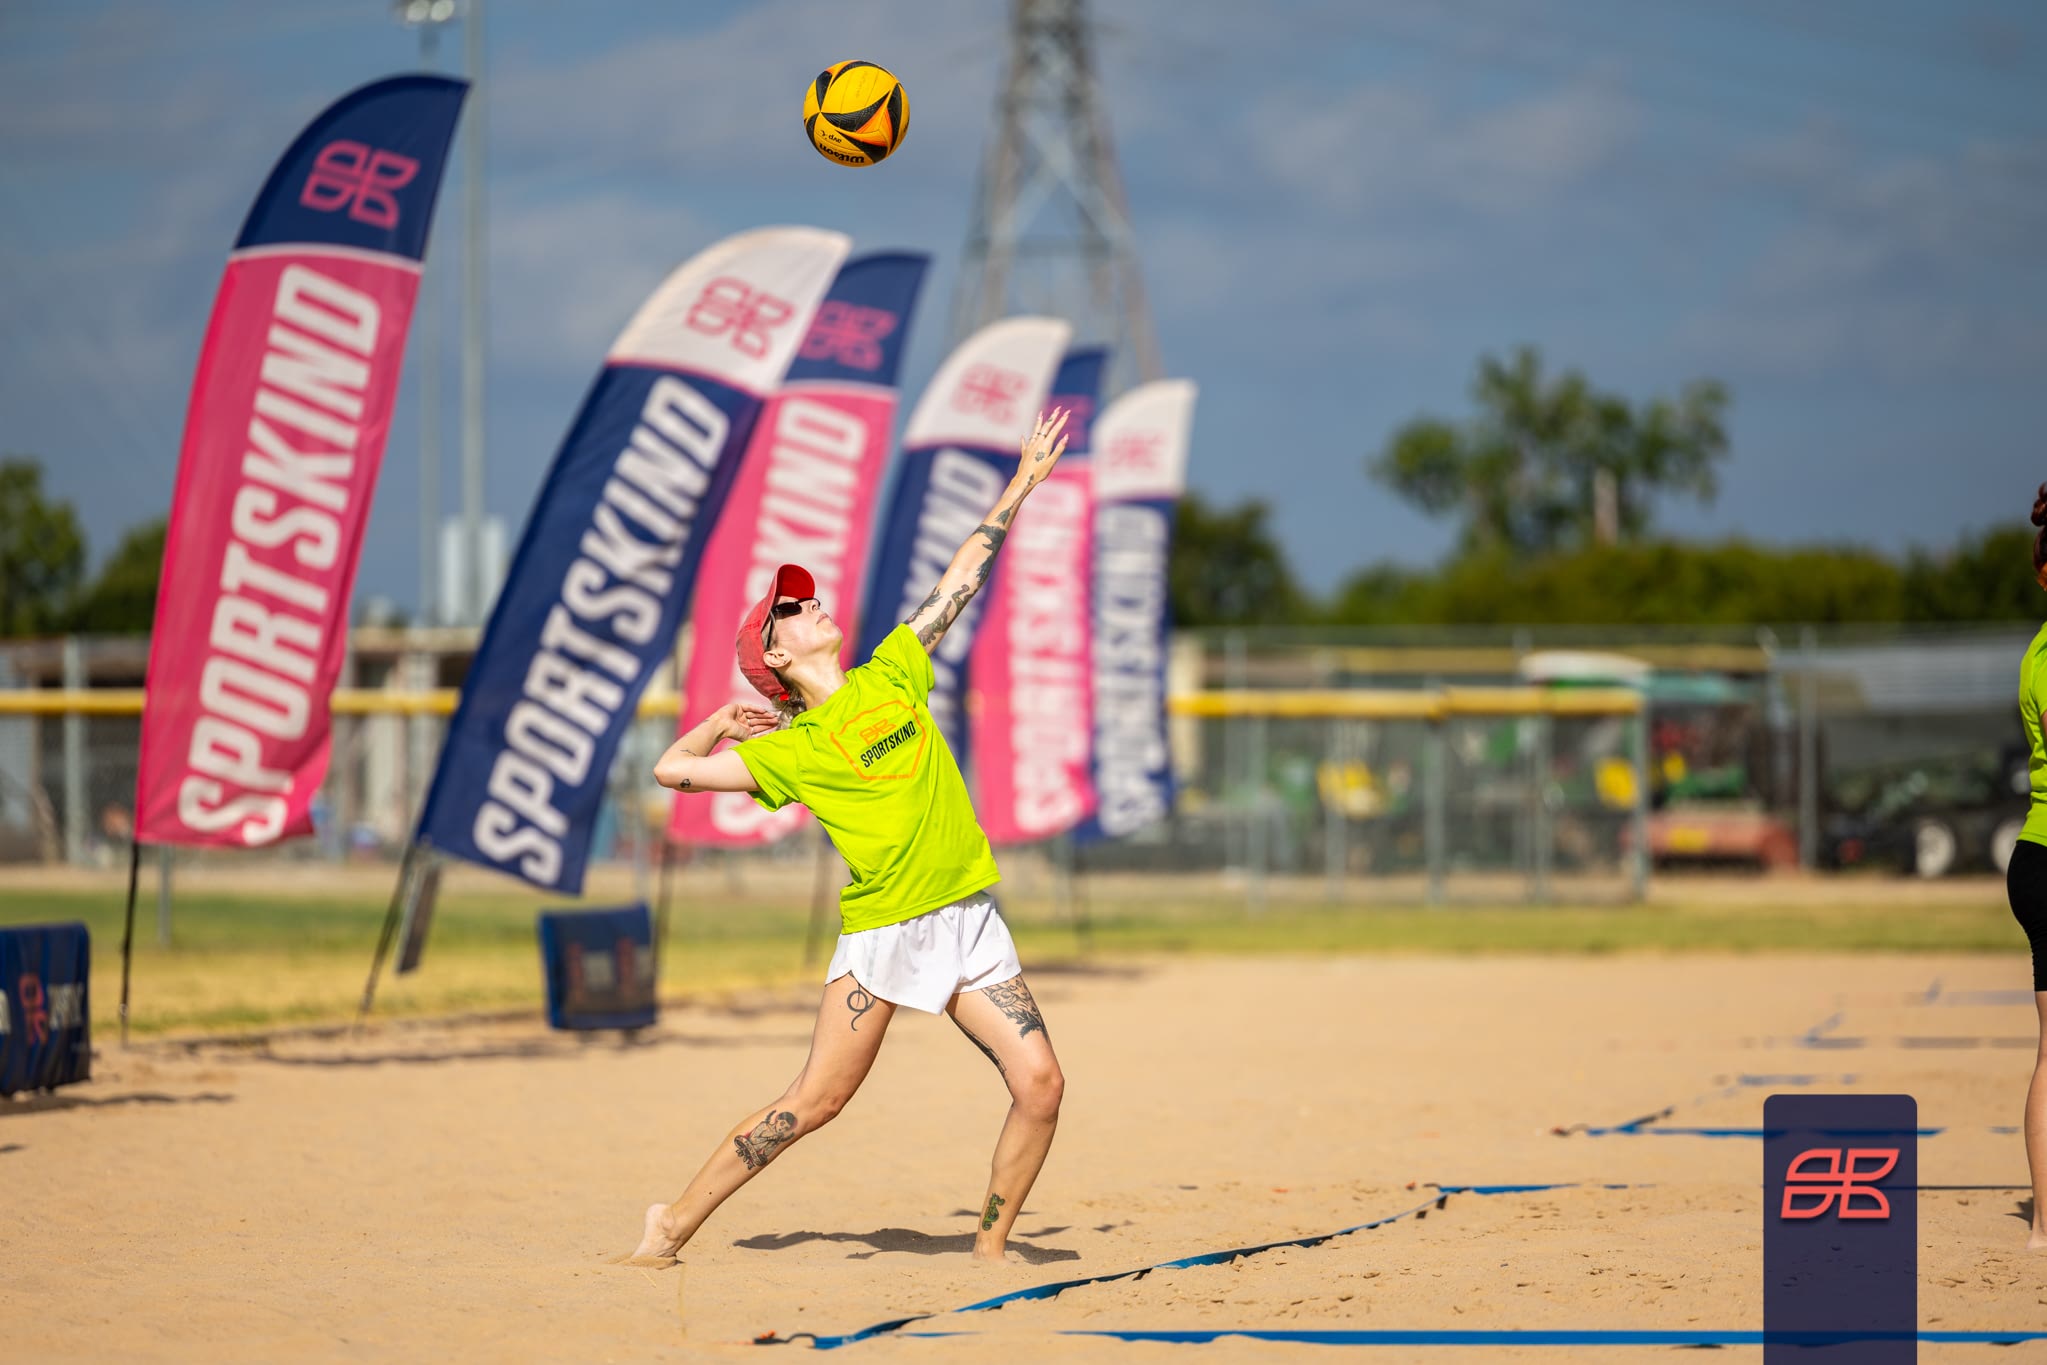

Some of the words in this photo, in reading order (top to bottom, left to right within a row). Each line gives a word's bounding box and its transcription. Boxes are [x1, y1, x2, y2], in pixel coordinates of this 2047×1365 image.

[177, 264, 382, 848] SPORTSKIND
[473, 374, 732, 886] SPORTSKIND
[860, 720, 917, 768] SPORTSKIND
